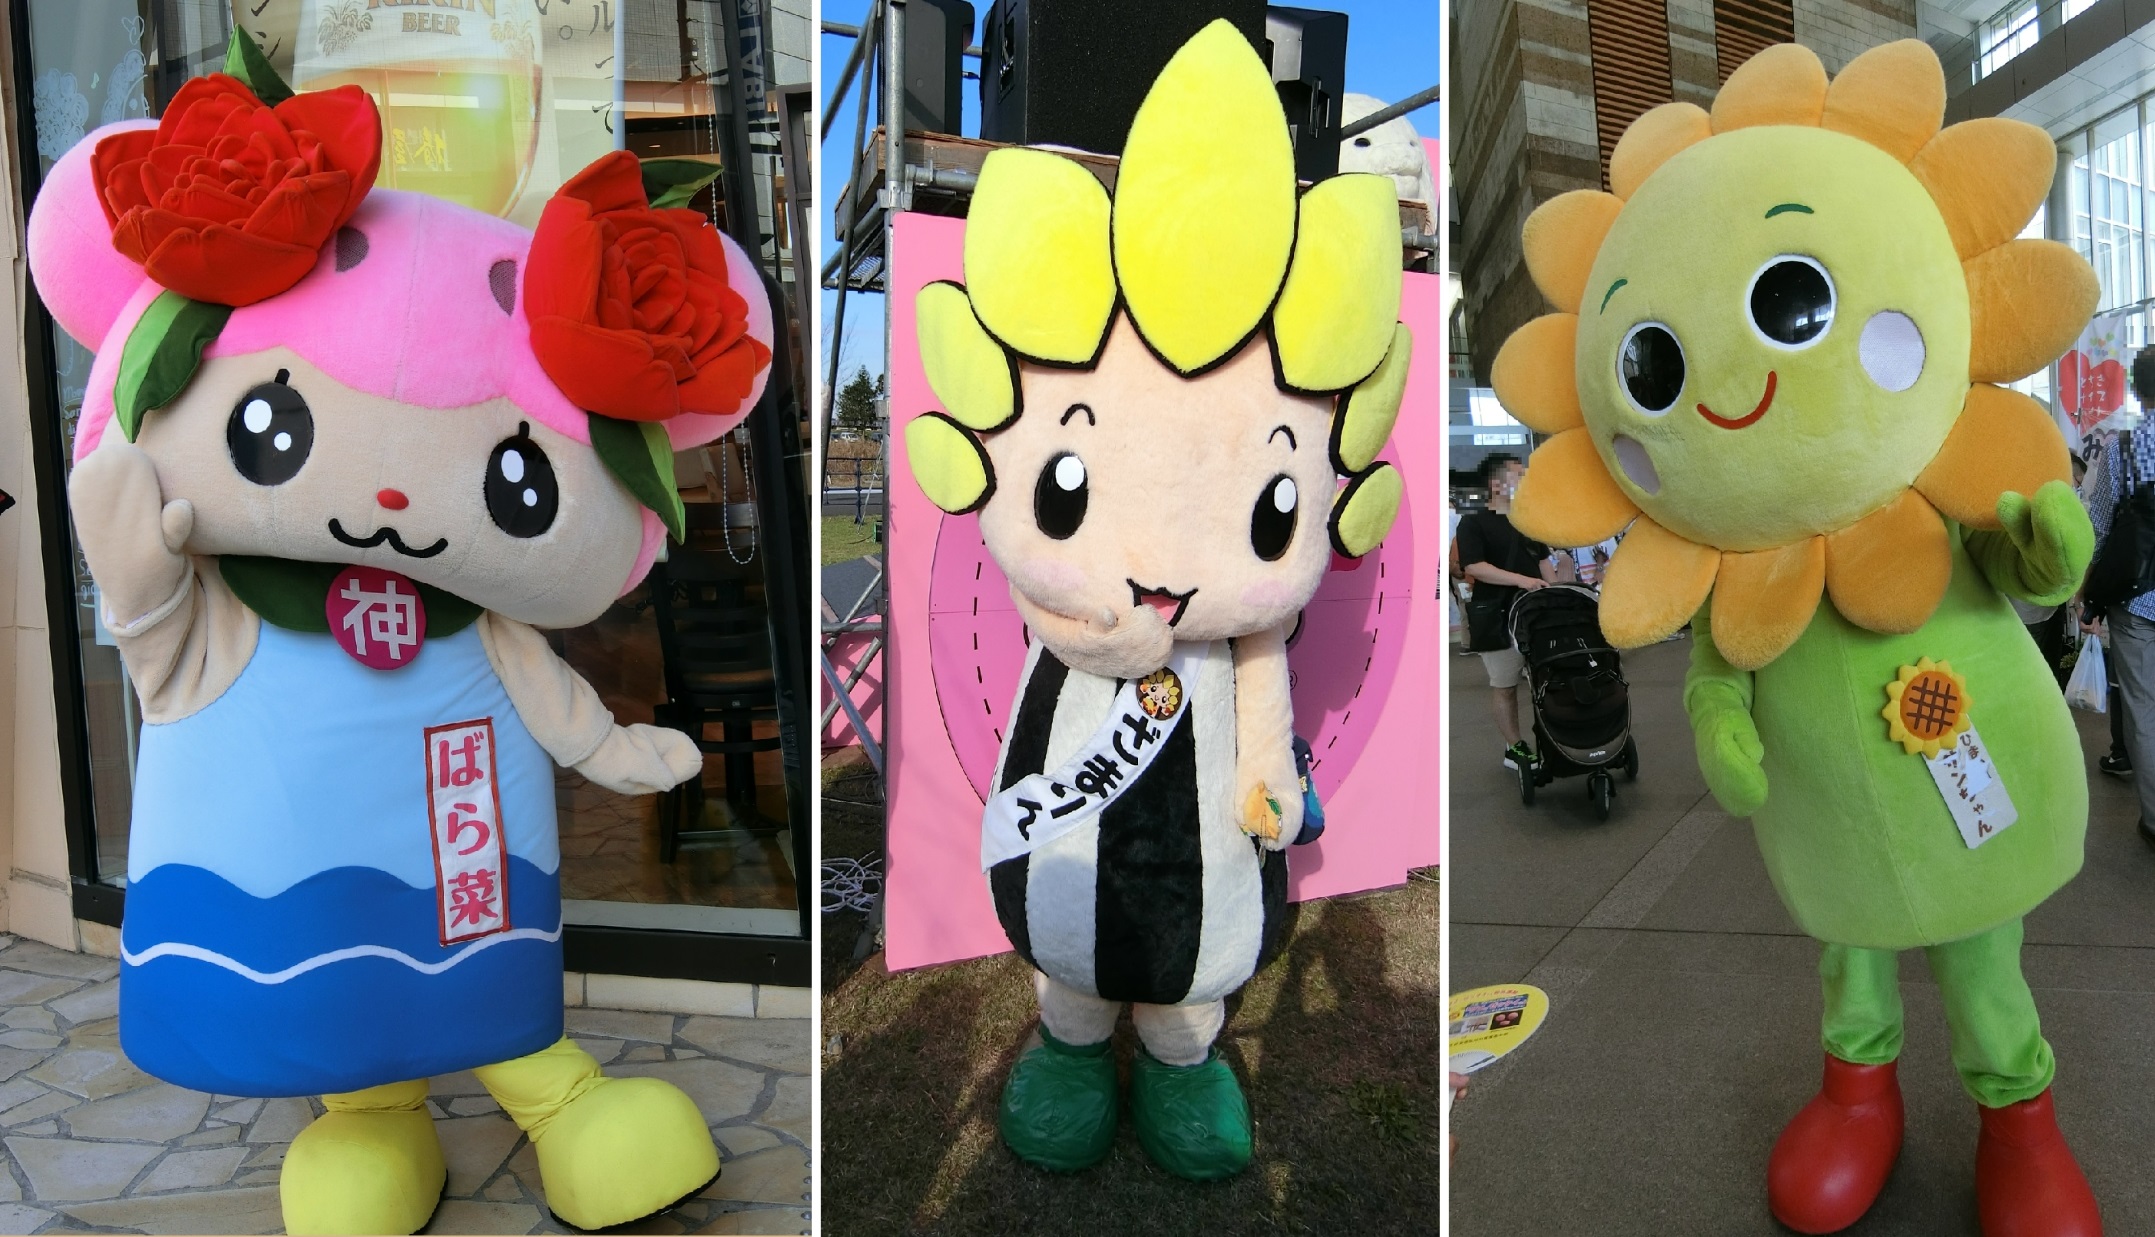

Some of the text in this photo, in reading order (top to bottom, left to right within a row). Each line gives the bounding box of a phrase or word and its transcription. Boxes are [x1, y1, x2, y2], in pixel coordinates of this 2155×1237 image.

[402, 12, 461, 36] BEER
[341, 579, 417, 660] 神
[1017, 713, 1161, 841] ざまりん
[439, 731, 499, 928] ばら菜
